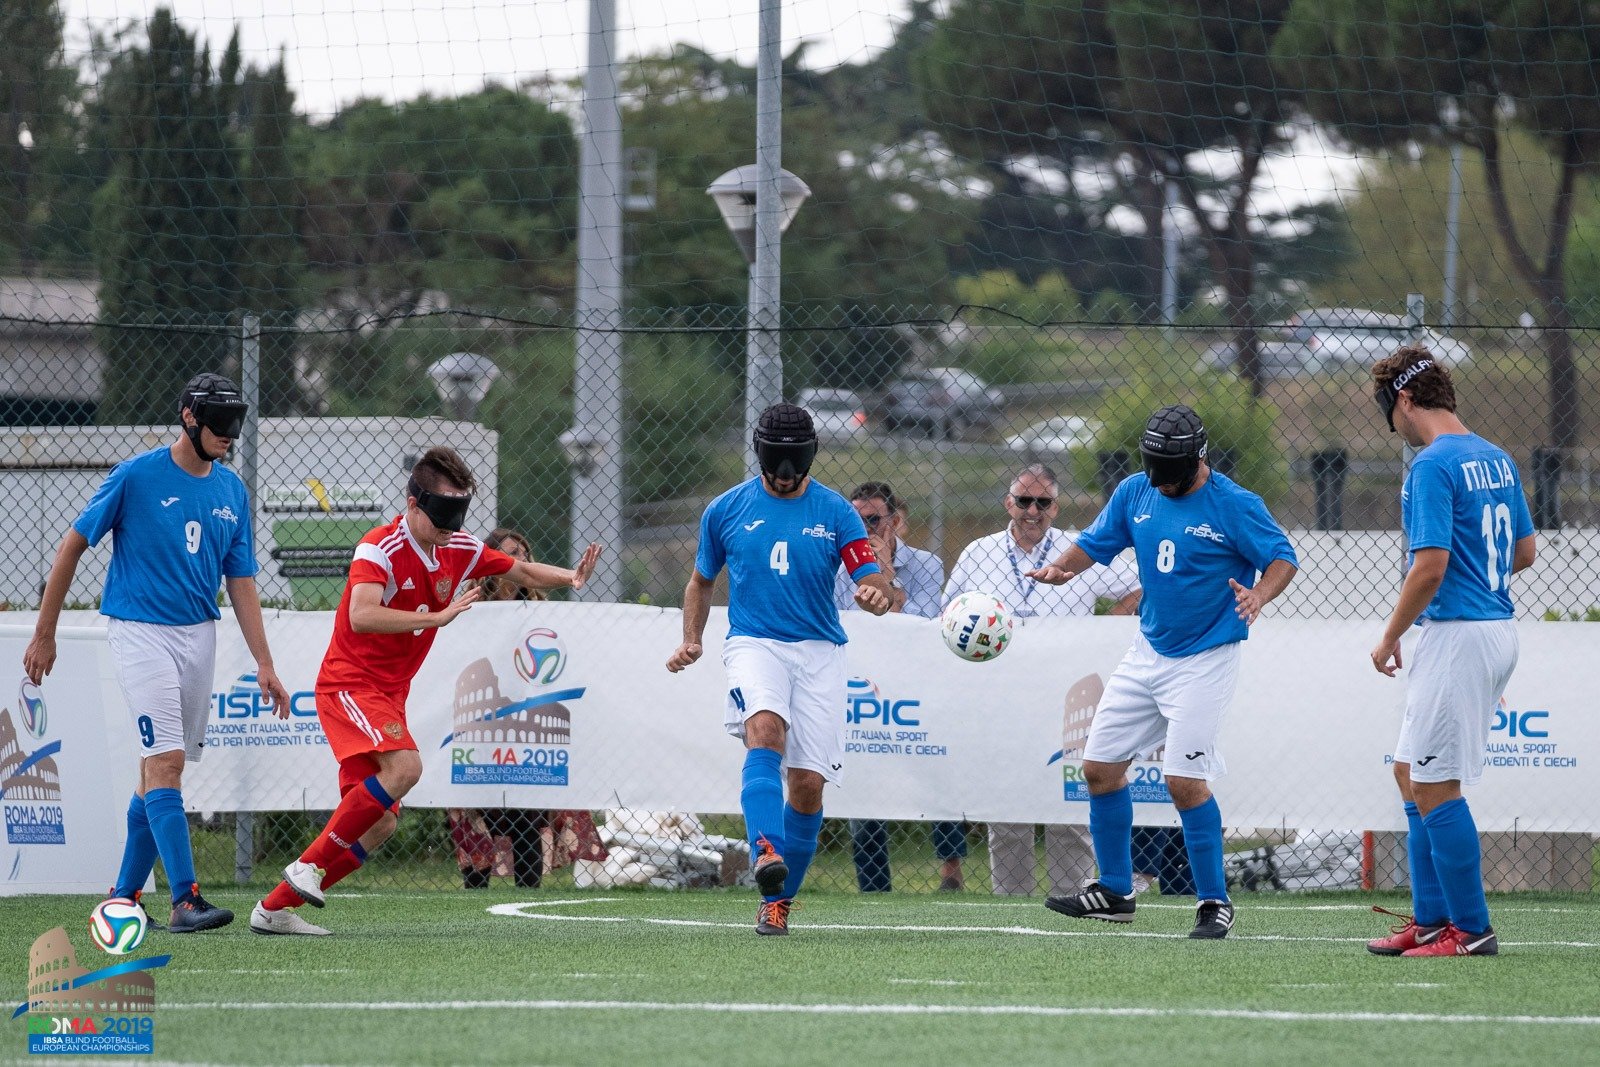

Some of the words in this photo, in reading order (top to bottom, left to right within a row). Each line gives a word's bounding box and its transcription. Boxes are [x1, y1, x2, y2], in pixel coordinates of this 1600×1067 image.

[1461, 458, 1515, 491] ITALIA
[185, 521, 201, 554] 9
[802, 527, 836, 541] FISPIC
[1184, 526, 1225, 543] FISPIC
[1482, 503, 1513, 591] 10
[770, 541, 790, 576] 4
[1157, 539, 1175, 573] 8
[138, 715, 155, 748] 9
[250, 723, 291, 733] ITALIANA
[223, 737, 243, 747] PER
[245, 735, 302, 747] IPOVEDENTI
[304, 735, 311, 745] E
[851, 730, 892, 741] ITALIANA
[895, 731, 929, 742] SPORT
[905, 744, 912, 755] E
[915, 745, 947, 756] CIECHI
[1486, 743, 1519, 753] ALIANA
[1523, 743, 1558, 754] SPORT
[522, 748, 569, 767] 2019
[1533, 756, 1540, 767] E
[1543, 757, 1577, 768] CIECHI
[464, 766, 485, 775] IBSA
[486, 766, 511, 775] BLIND
[512, 767, 554, 776] FOOTBALL
[453, 773, 501, 782] EUROPEAN
[502, 774, 566, 784] CHAMPIONSHIPS
[1129, 785, 1167, 793] OOTBALL
[4, 805, 38, 825] ROMA
[39, 805, 63, 825] 2019
